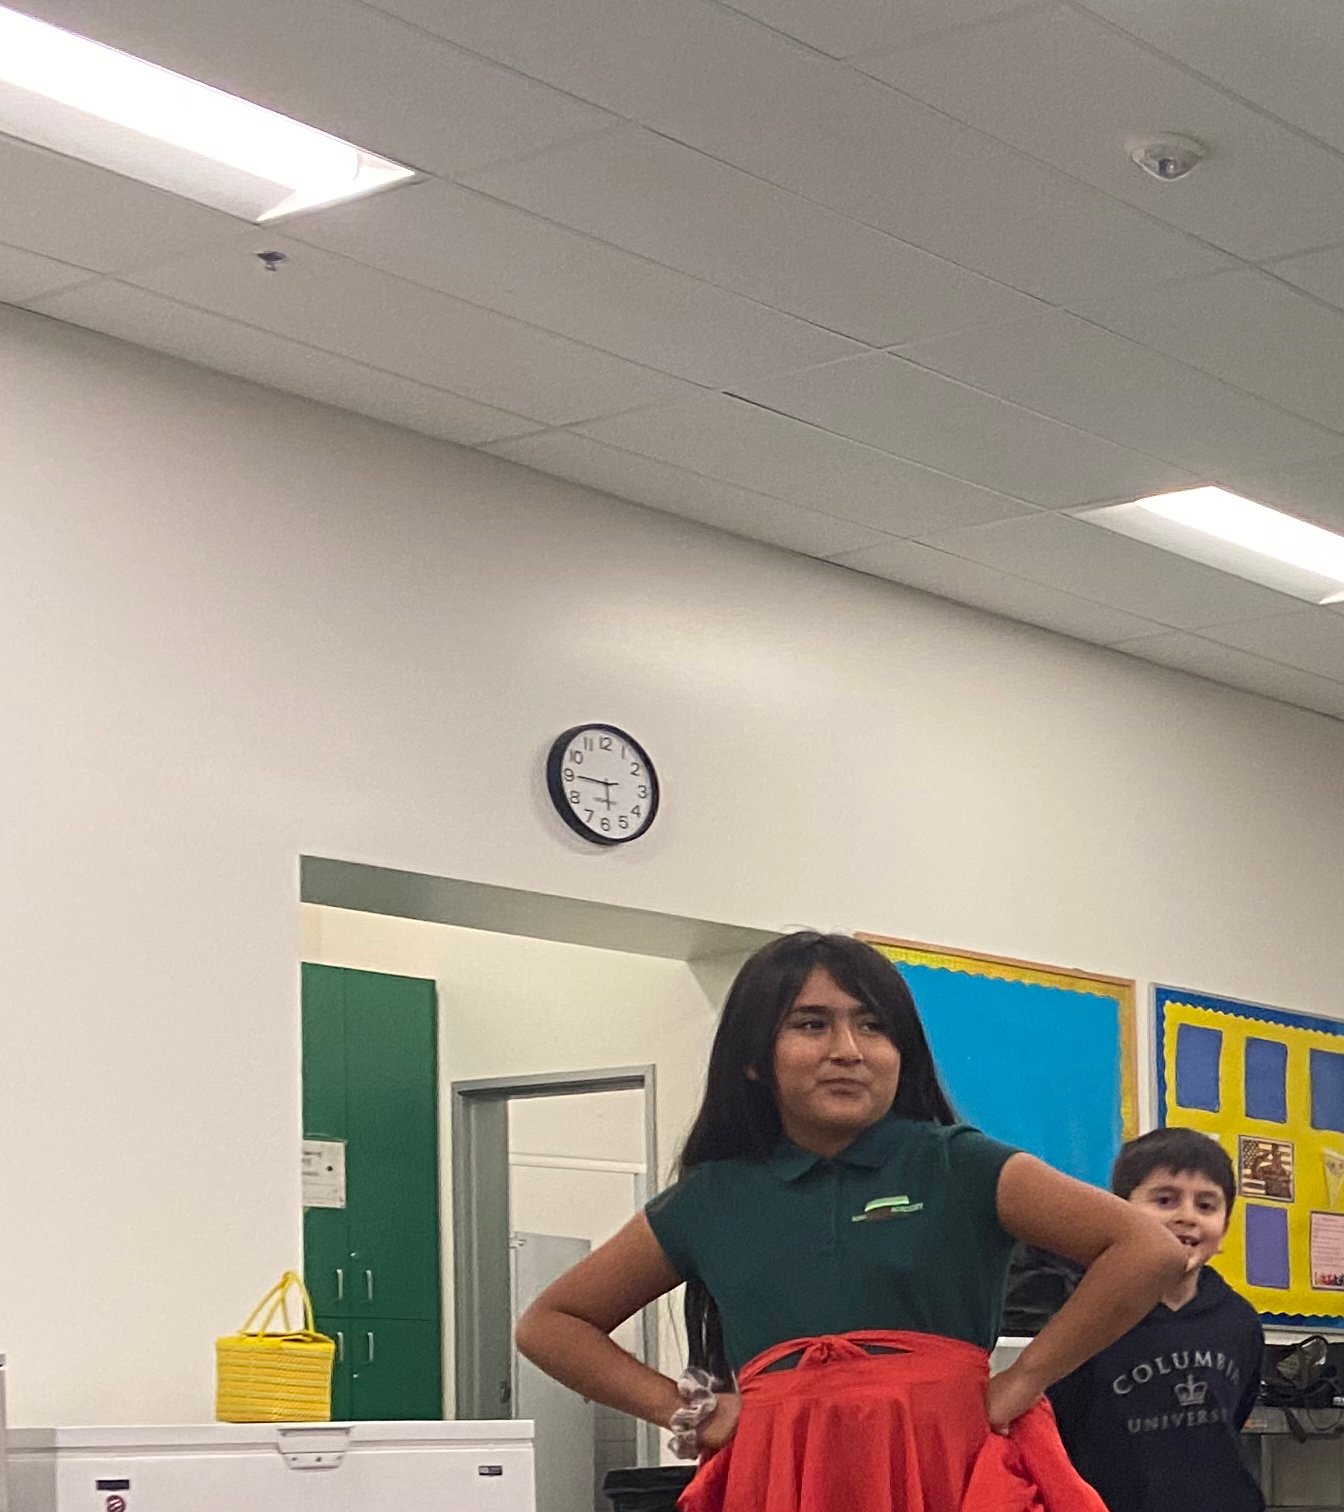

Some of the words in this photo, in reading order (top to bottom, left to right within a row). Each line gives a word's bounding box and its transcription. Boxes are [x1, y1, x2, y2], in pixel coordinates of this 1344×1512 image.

[583, 736, 594, 752] 11
[600, 736, 612, 751] 12
[569, 750, 584, 765] 10
[563, 768, 575, 782] 9
[630, 762, 640, 777] 2
[570, 790, 580, 804] 8
[638, 785, 647, 799] 3
[584, 808, 594, 823] 7
[630, 805, 642, 818] 4
[600, 817, 611, 832] 6
[618, 815, 629, 829] 5
[1112, 1350, 1241, 1395] COLUMBIA
